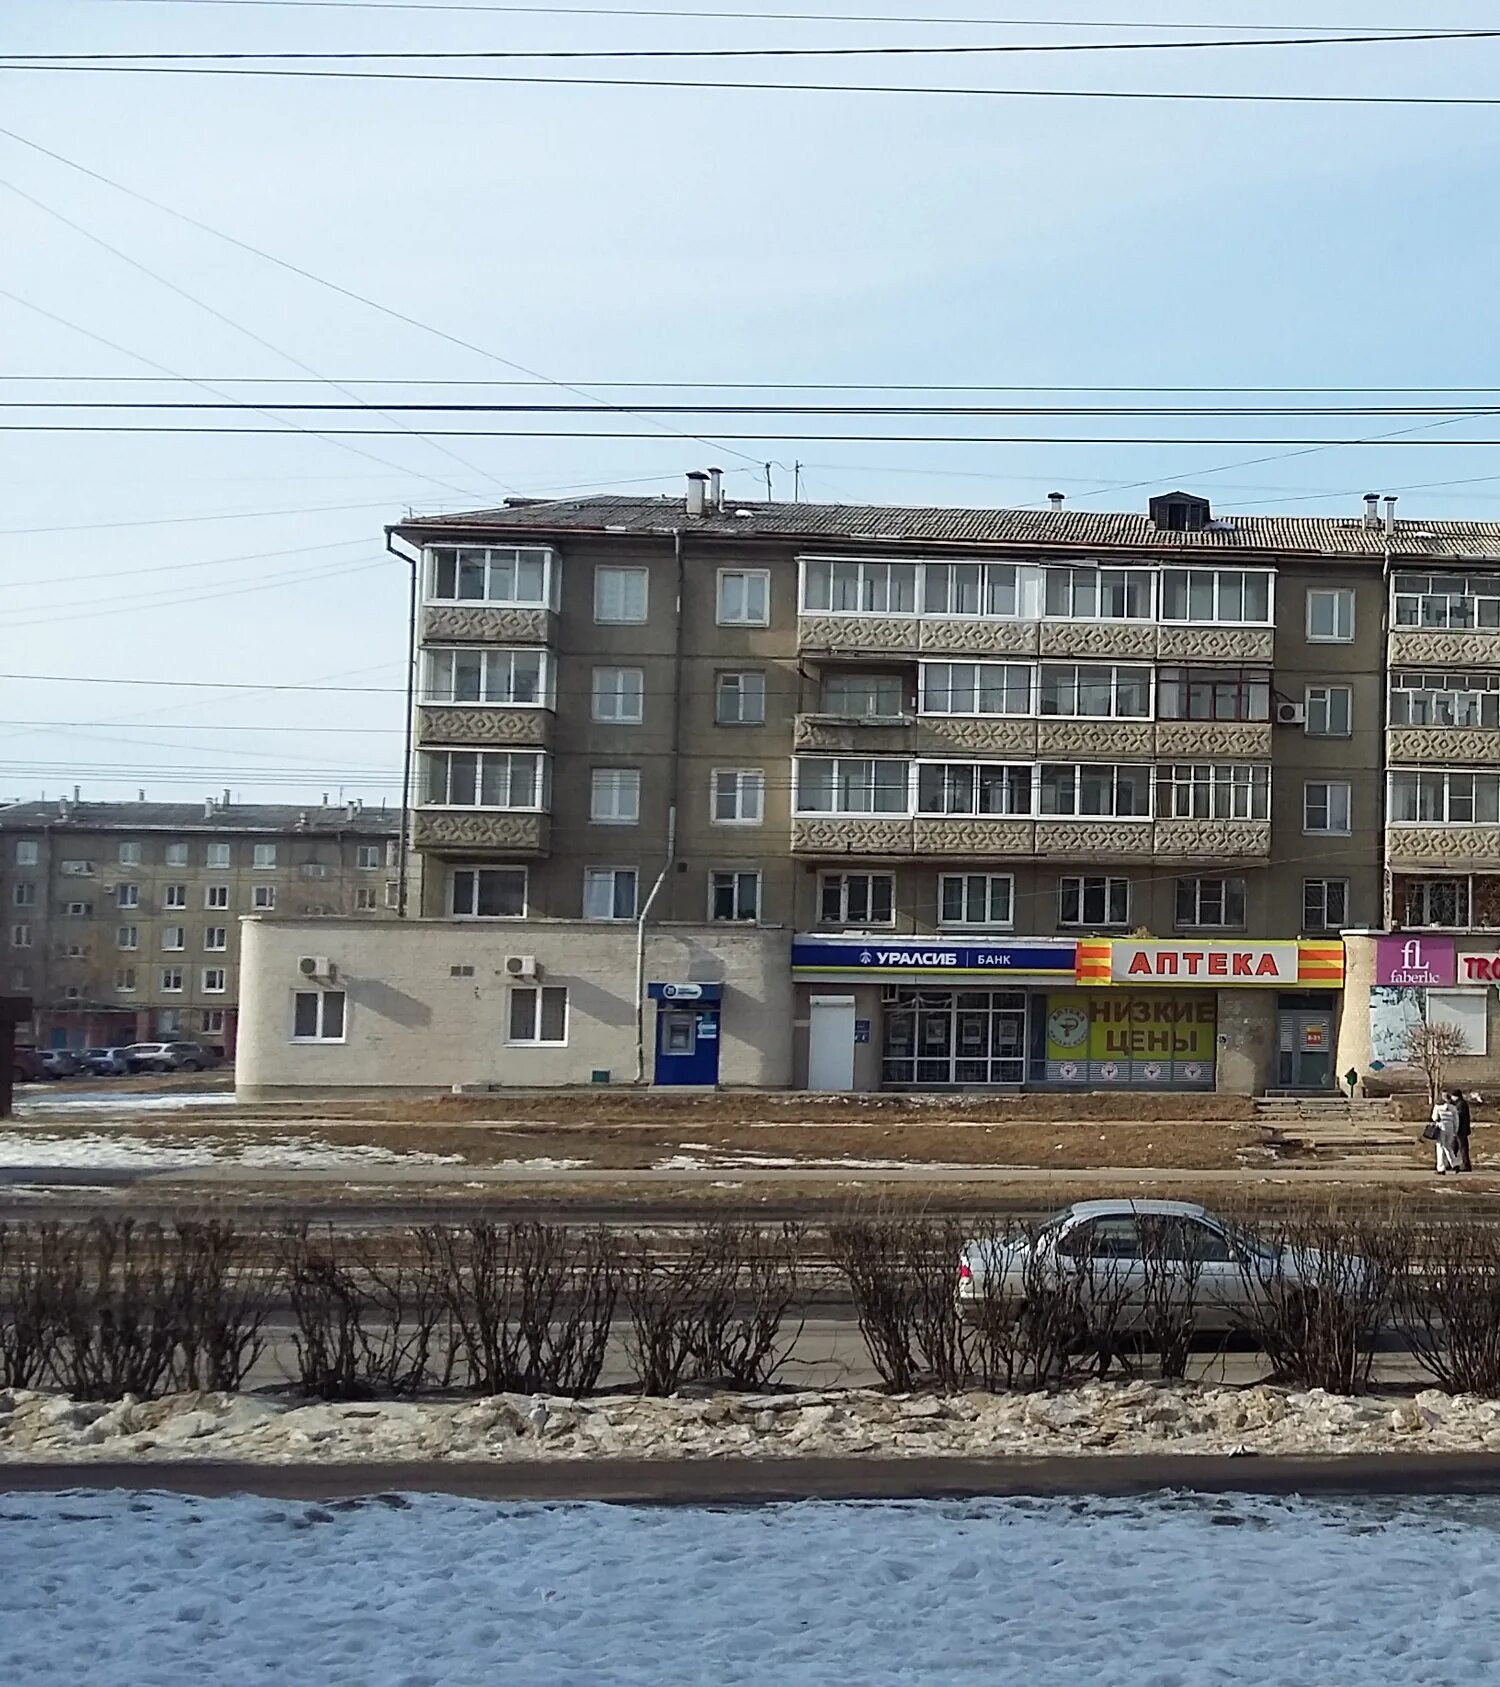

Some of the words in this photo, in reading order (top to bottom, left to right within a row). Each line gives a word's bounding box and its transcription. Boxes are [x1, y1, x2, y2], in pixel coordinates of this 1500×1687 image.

[876, 952, 957, 966] УРАЛСИБ
[977, 954, 1011, 965] БАНК
[1128, 951, 1280, 976] АПТЕКА
[1390, 969, 1440, 983] faberlic
[1090, 1001, 1215, 1023] НИЗКИЕ
[1106, 1030, 1198, 1056] ЦЕНЫ
